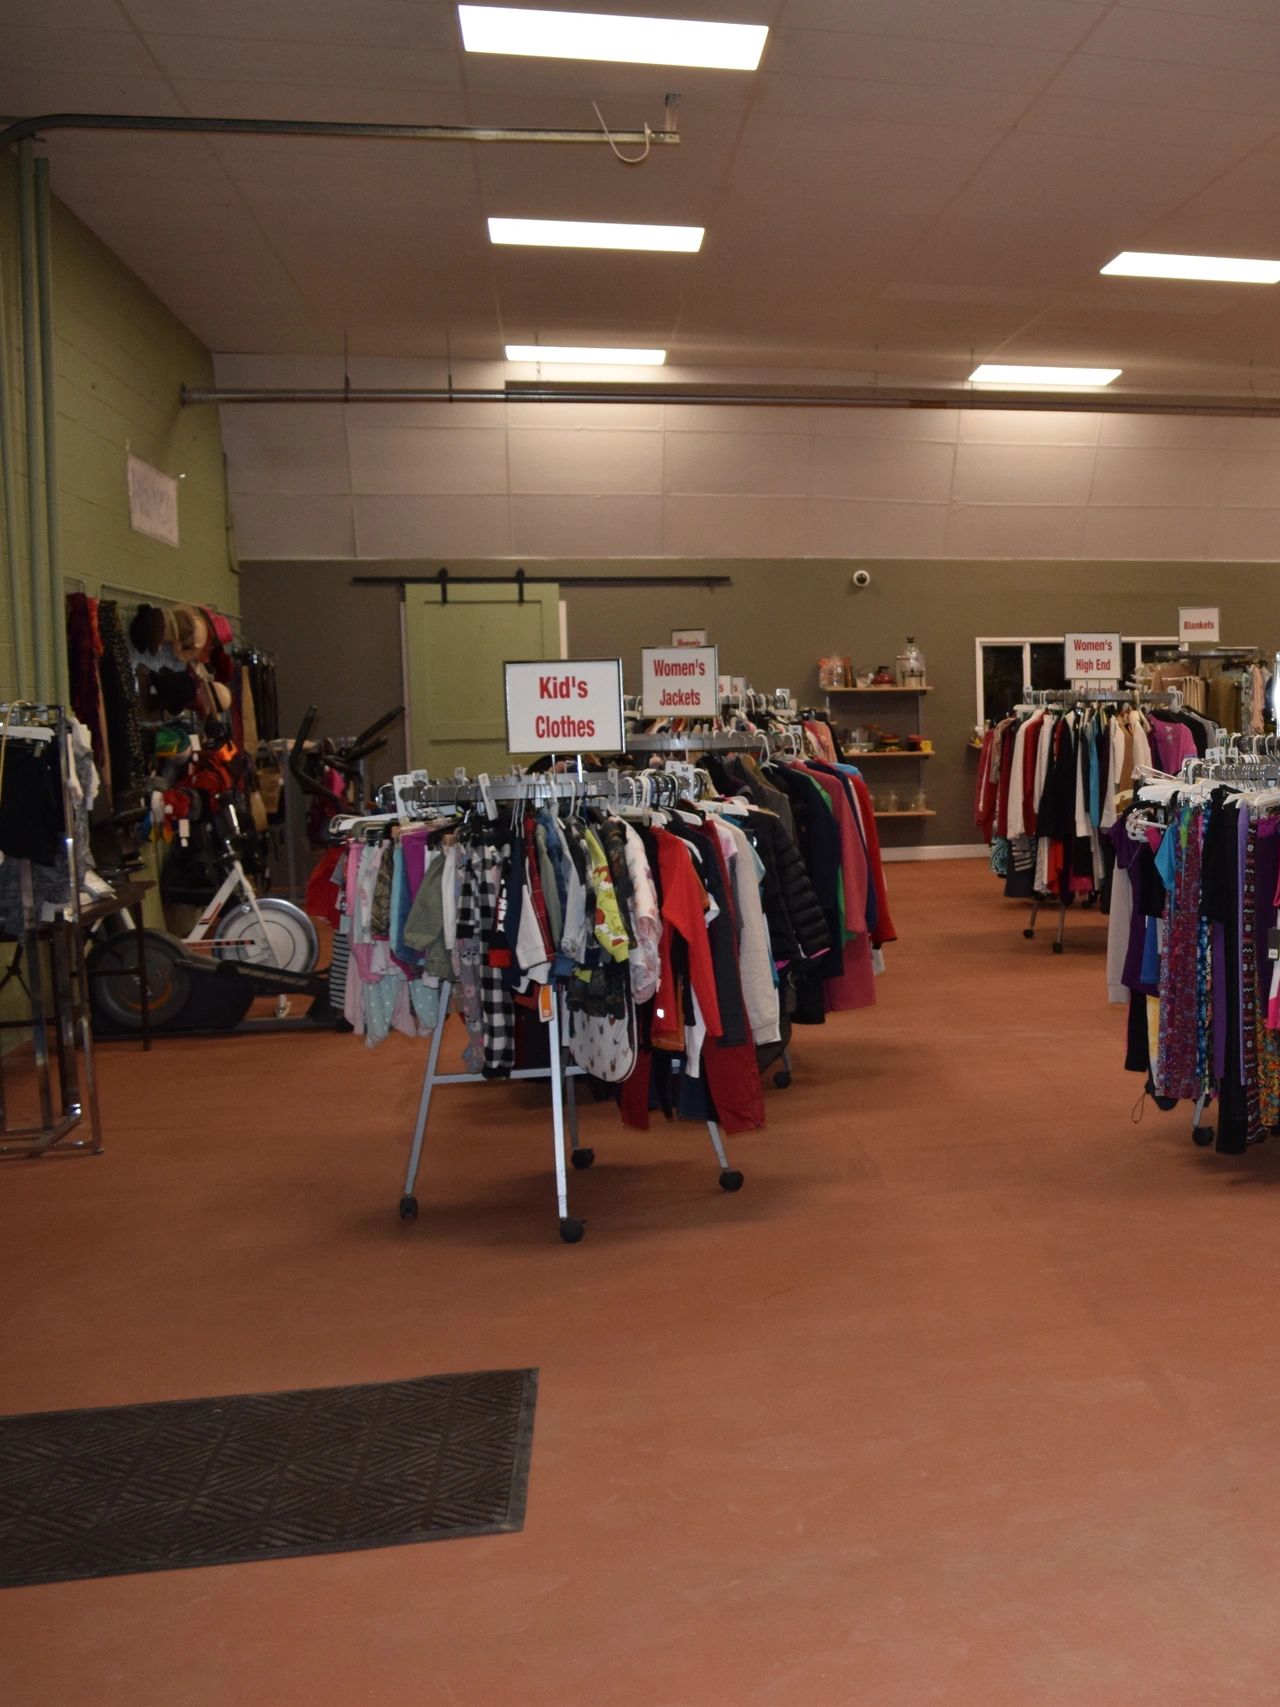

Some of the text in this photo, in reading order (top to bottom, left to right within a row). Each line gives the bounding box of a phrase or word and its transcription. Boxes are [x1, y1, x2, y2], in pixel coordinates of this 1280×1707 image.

[1184, 620, 1214, 630] Blankets
[1073, 639, 1112, 651] Women's
[653, 659, 705, 676] Women's
[1076, 659, 1111, 672] High End
[539, 677, 588, 699] Kid's
[659, 689, 701, 706] Jackets
[535, 716, 595, 738] Clothes
